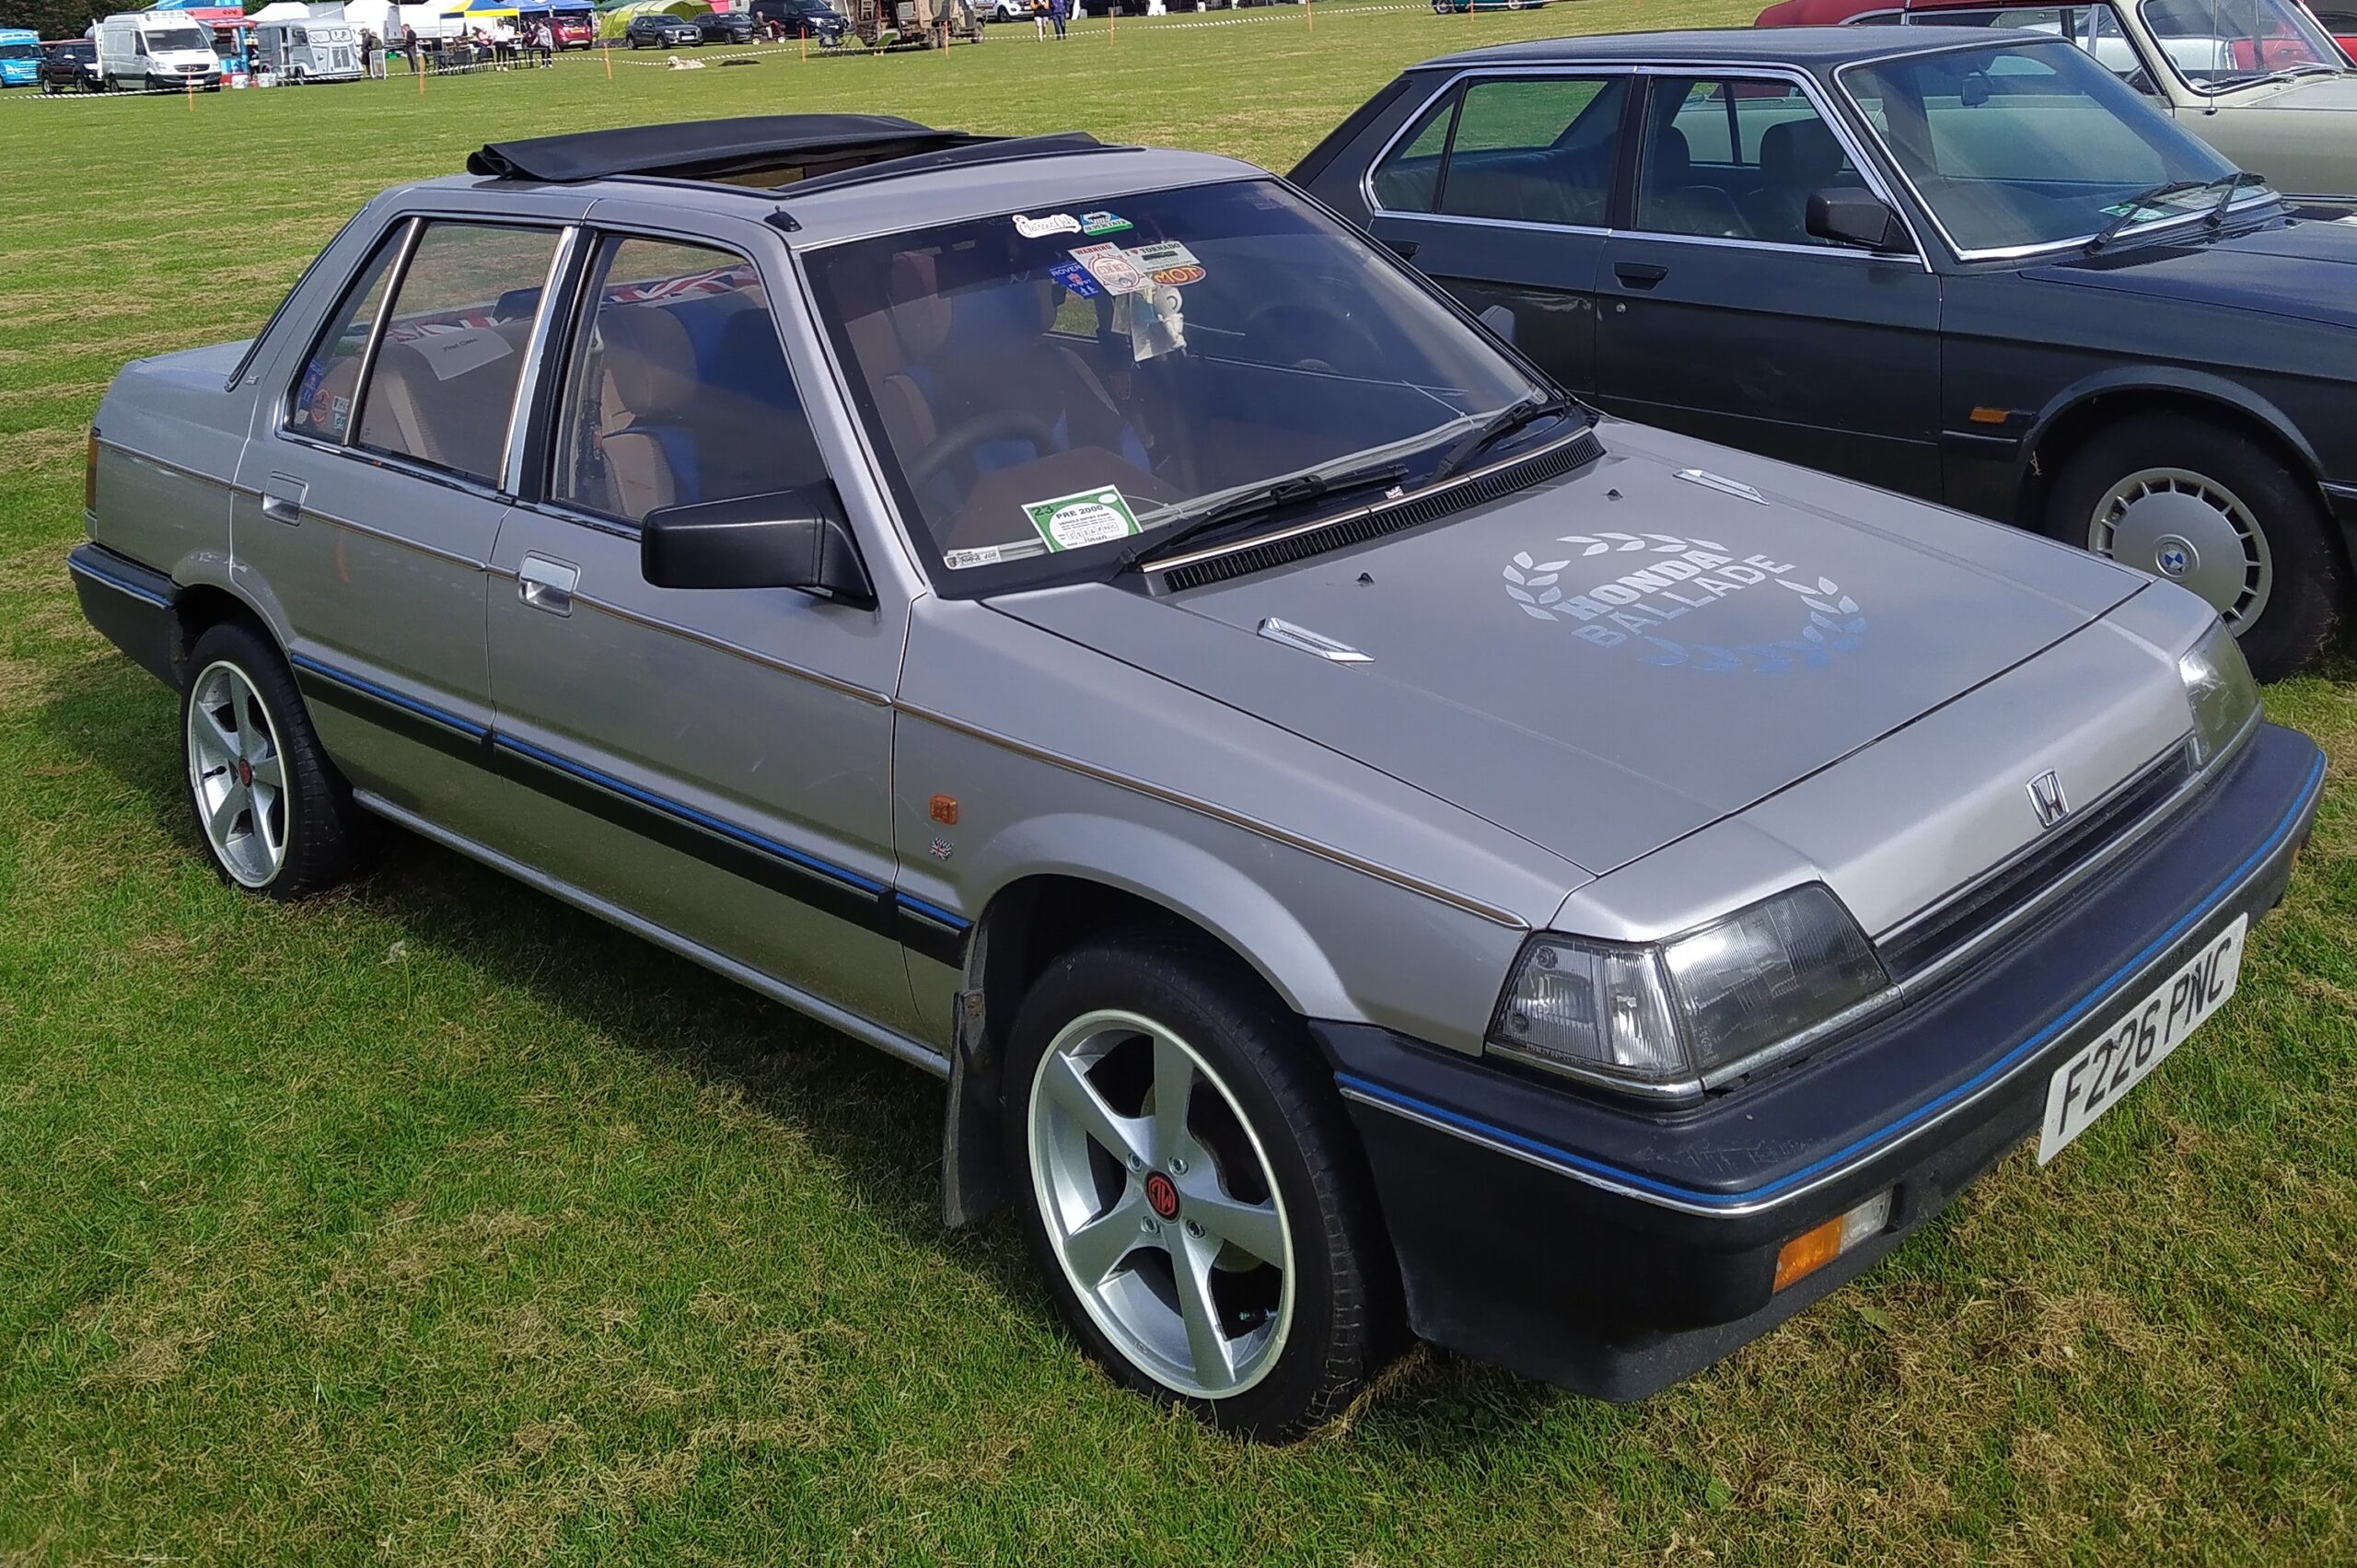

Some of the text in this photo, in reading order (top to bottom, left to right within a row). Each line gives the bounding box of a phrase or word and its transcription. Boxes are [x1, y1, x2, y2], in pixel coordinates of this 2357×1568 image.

[1074, 243, 1112, 256] WARNING
[1139, 242, 1181, 254] TORNADO
[1051, 264, 1083, 277] ROVER
[1154, 267, 1199, 284] MOT
[1031, 505, 1054, 517] 23
[1055, 505, 1104, 519] PRE 2000
[1550, 550, 1734, 622] HONDA
[1571, 554, 1796, 649] BALLADE
[2058, 935, 2233, 1137] F226 PNC
